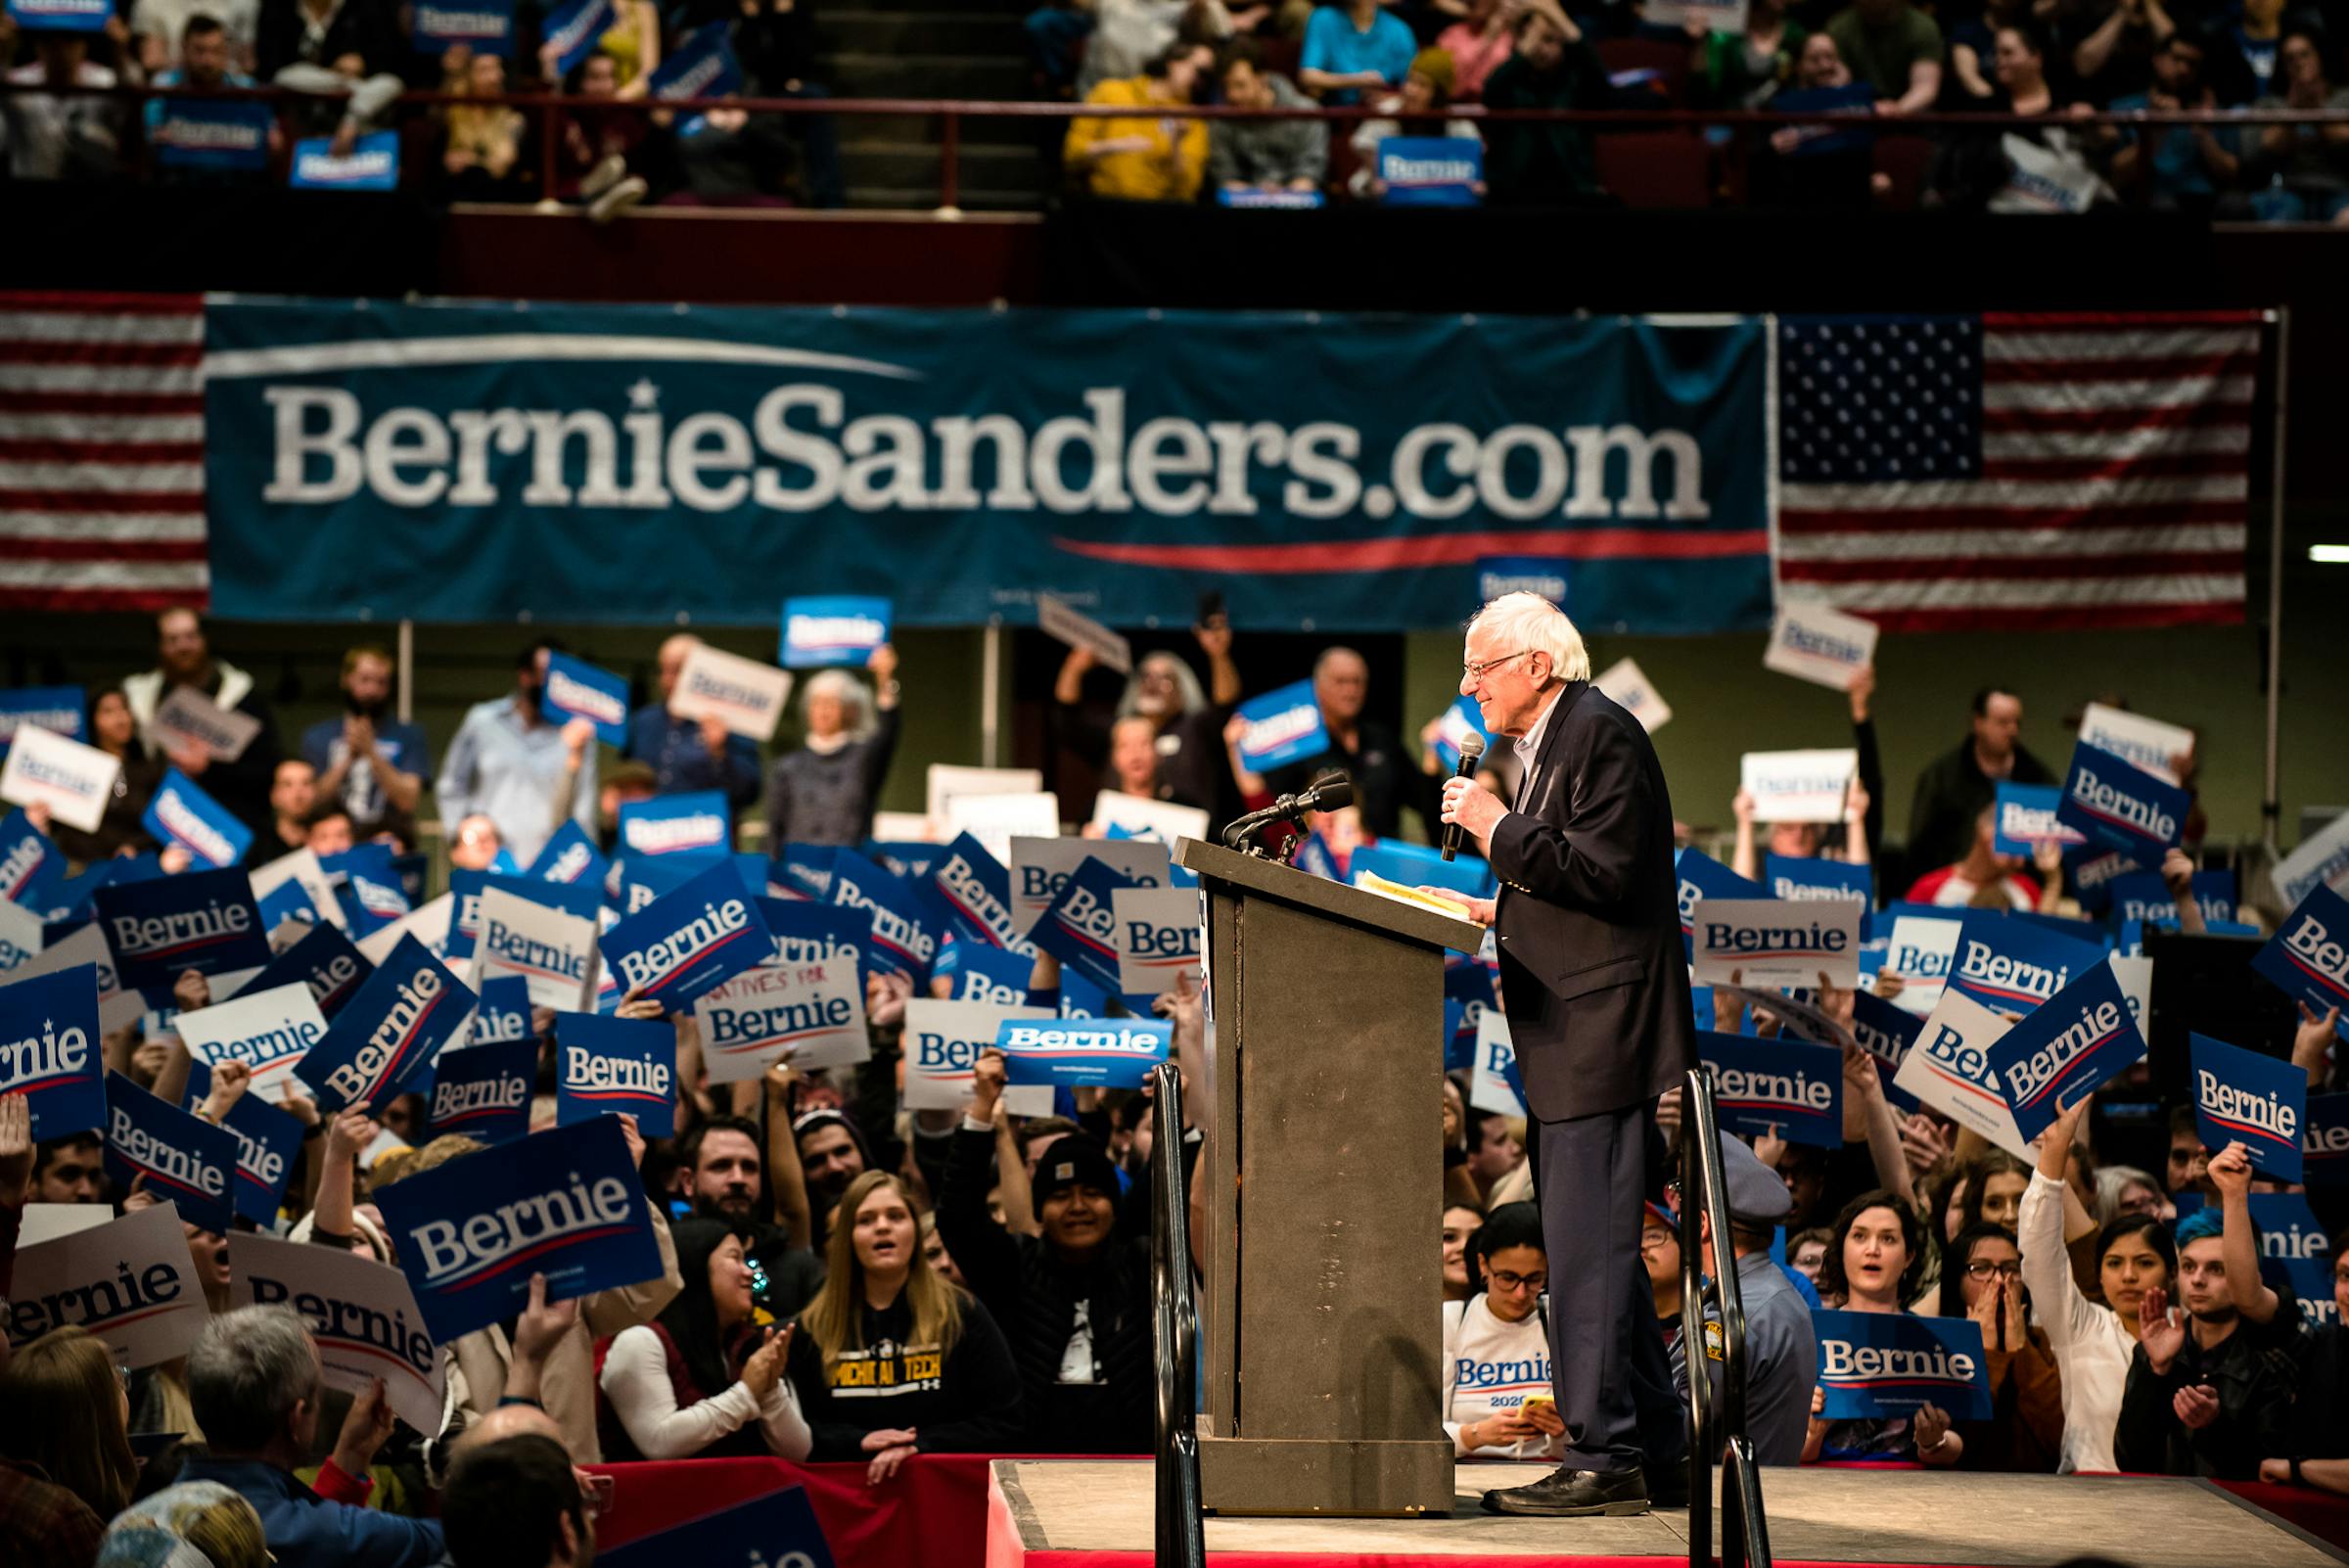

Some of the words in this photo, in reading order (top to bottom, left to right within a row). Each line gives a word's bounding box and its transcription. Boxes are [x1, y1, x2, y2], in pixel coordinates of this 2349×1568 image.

[262, 379, 1710, 523] BernieSanders.com
[2073, 767, 2175, 842] Bernie
[112, 899, 251, 950] Bernie
[2125, 896, 2230, 921] Berie
[486, 920, 588, 979] Bernie
[618, 898, 748, 990] Bernie
[770, 933, 859, 964] rnie
[1128, 921, 1200, 956] Ber
[1705, 922, 1848, 951] Bernie
[1897, 945, 1953, 977] Ber
[2286, 914, 2349, 990] Ber
[310, 955, 358, 1003] nie
[961, 970, 1028, 1007] Ber
[1960, 940, 2068, 995] Berni
[199, 1016, 320, 1067] Bernie
[324, 967, 440, 1105] Bernie
[474, 1006, 525, 1045] nie
[709, 992, 852, 1042] Bernie
[1006, 1027, 1160, 1053] Bernie
[0, 1018, 88, 1088] nie
[918, 1032, 994, 1070] Ber
[1854, 1020, 1911, 1066] rni
[2004, 1000, 2121, 1103] Bernie
[431, 1071, 527, 1118] Bernie
[566, 1046, 670, 1096] Bernie
[2198, 1069, 2296, 1139] Bernie
[109, 1105, 225, 1197] Bernie
[410, 1170, 631, 1279] Bernie
[2262, 1223, 2329, 1260] nie
[8, 1260, 182, 1337] ernie
[903, 1353, 942, 1381] TECH
[1821, 1337, 1975, 1381] Bernie
